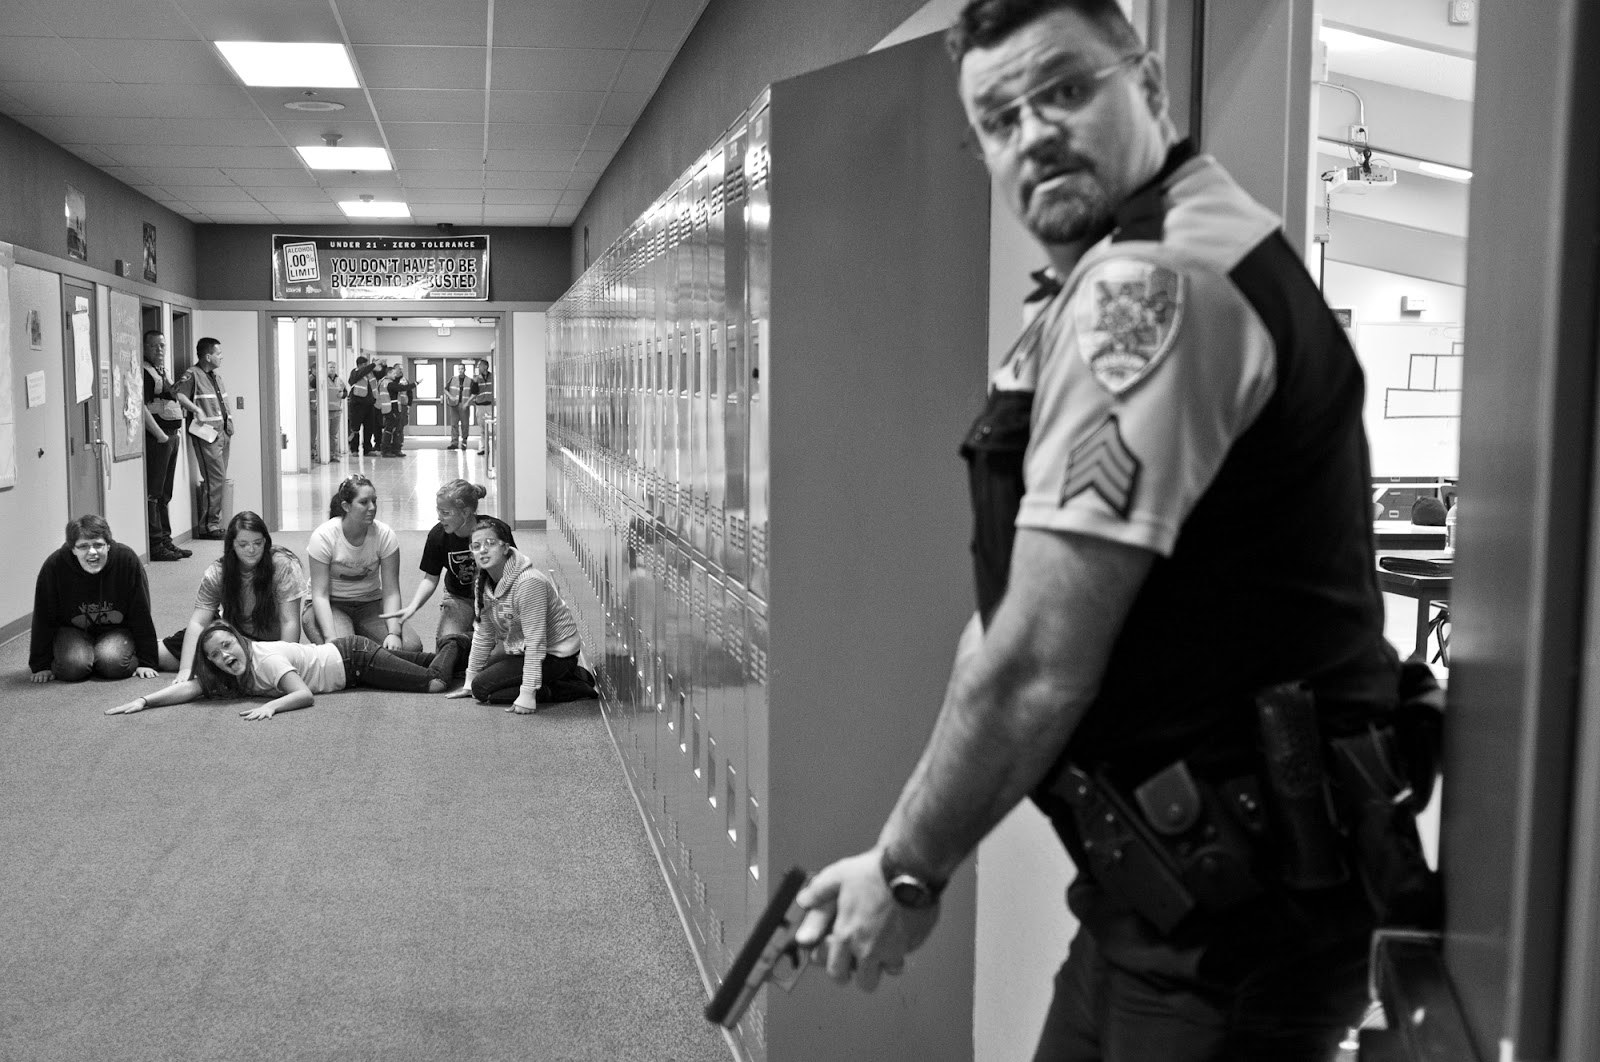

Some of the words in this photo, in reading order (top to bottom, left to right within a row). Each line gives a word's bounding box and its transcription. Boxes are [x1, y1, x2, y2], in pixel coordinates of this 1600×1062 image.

[287, 246, 313, 254] ALCOHOL
[329, 241, 361, 249] UNDER
[366, 241, 377, 249] 21
[392, 241, 417, 249] ZERO
[421, 241, 476, 249] TOLERANCE
[331, 258, 357, 274] YOU
[360, 258, 400, 274] DON'T
[402, 258, 436, 274] HAVE
[437, 258, 456, 274] TO
[458, 258, 477, 274] BE
[290, 267, 316, 278] LIMIT
[331, 273, 383, 289] BUZZED
[385, 273, 402, 288] TO
